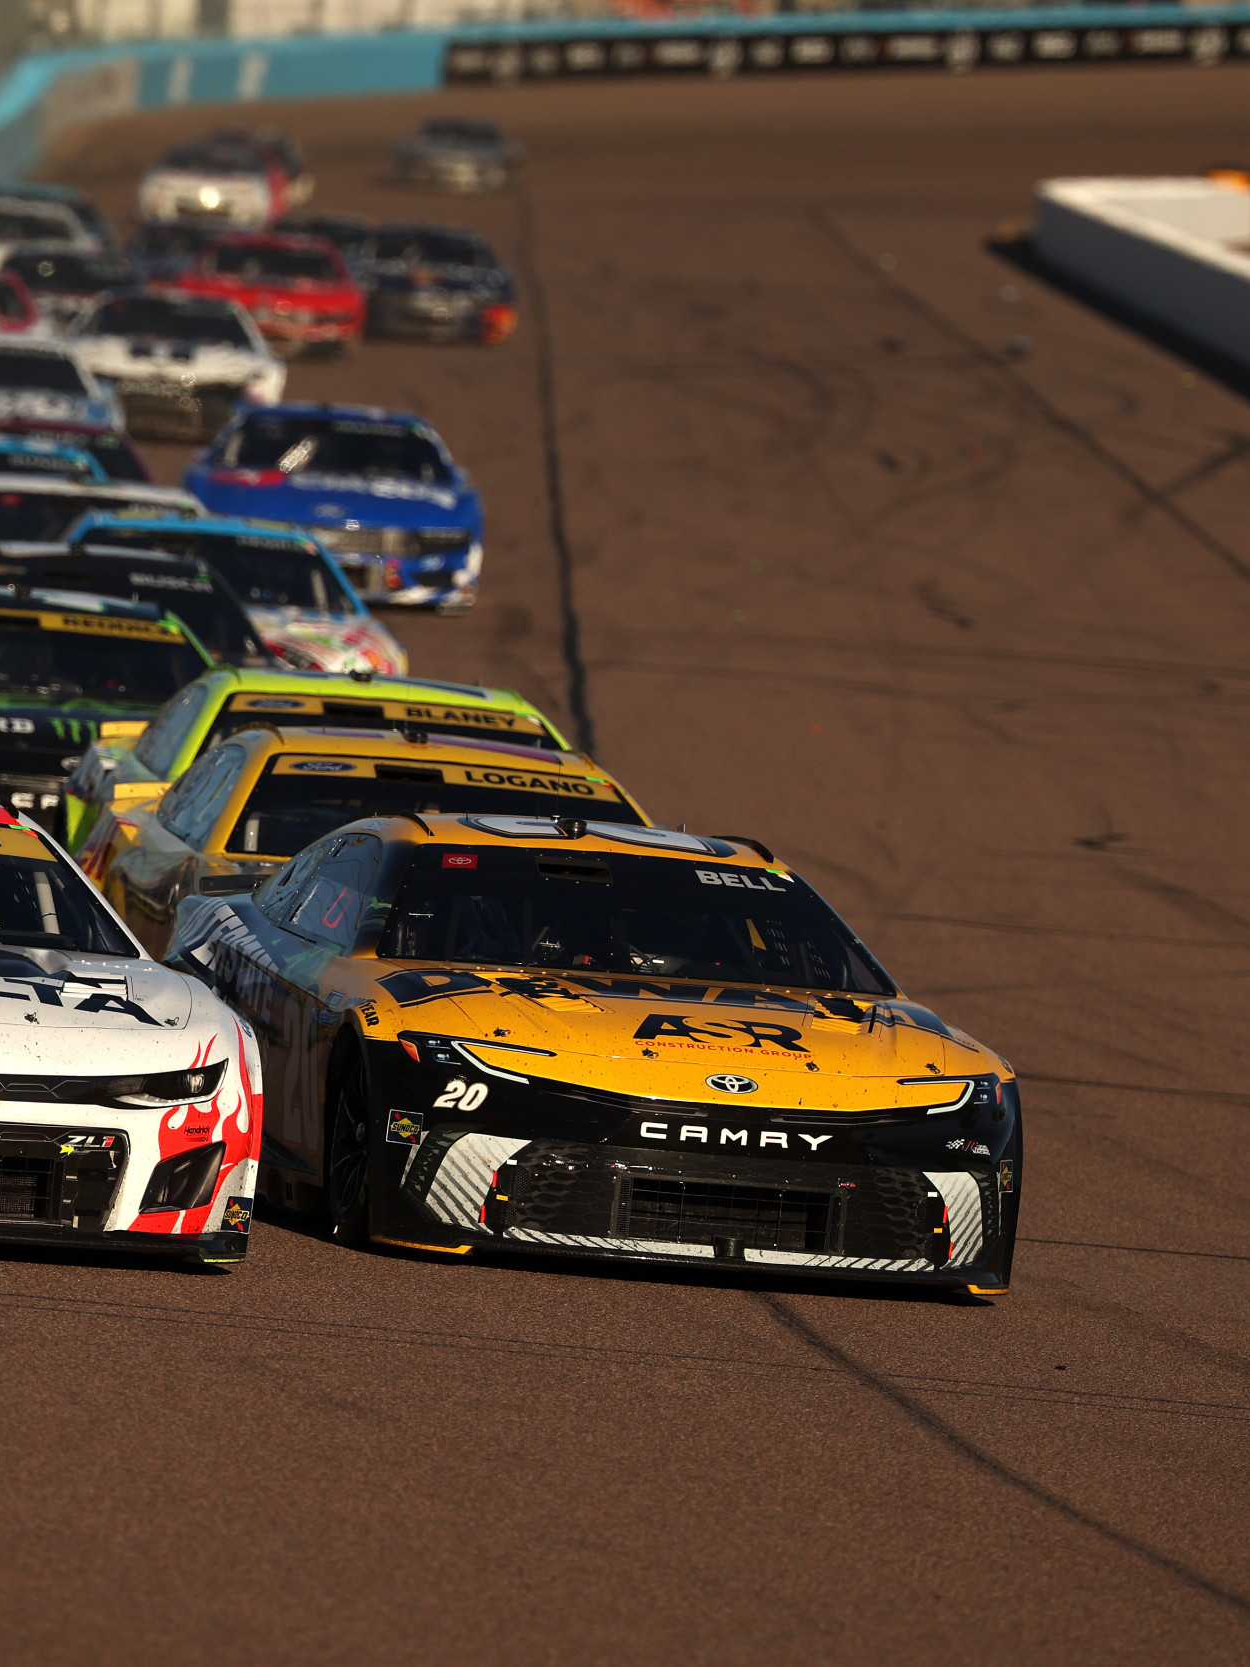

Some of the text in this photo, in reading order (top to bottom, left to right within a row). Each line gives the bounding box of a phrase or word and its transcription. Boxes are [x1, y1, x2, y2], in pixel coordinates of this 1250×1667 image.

[404, 706, 518, 729] BLANEY
[465, 770, 594, 796] LOGANO
[695, 869, 787, 893] BELL
[633, 1013, 812, 1053] ASR
[635, 1040, 813, 1060] CONSTRUCTION GROUP
[432, 1080, 490, 1112] 20
[391, 1122, 420, 1135] SUNOCO
[640, 1121, 834, 1151] CAMRY
[63, 1135, 116, 1148] ZL1
[224, 1209, 249, 1221] SUNOCO
